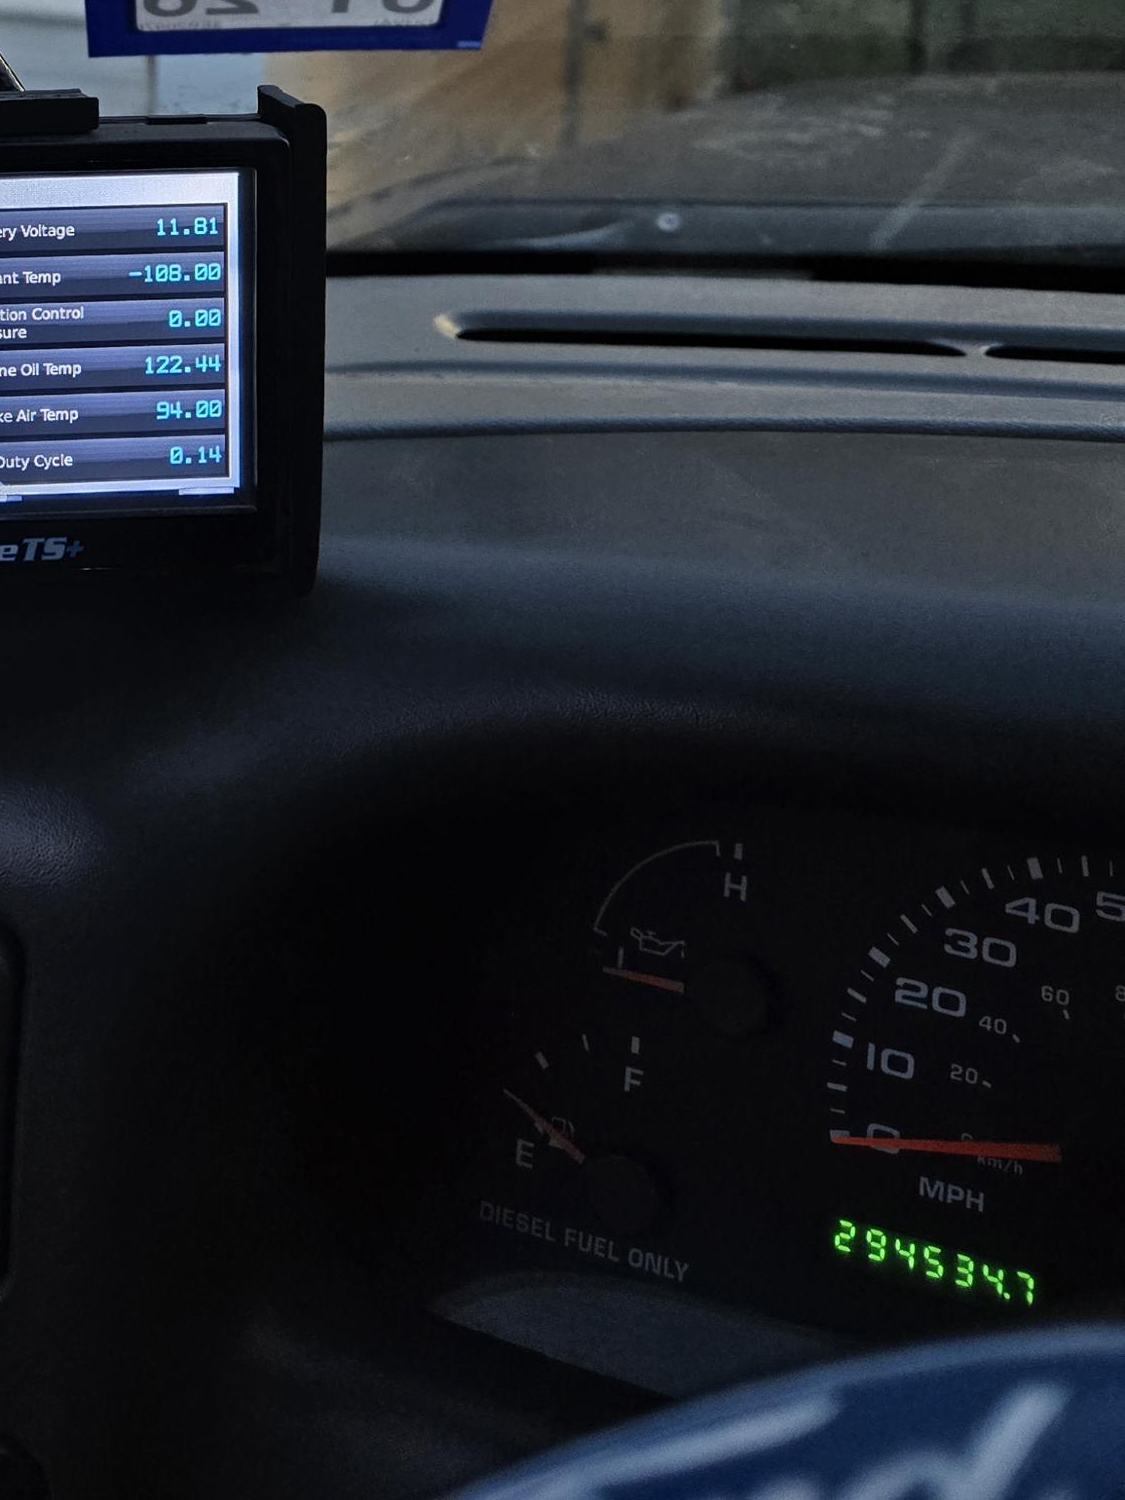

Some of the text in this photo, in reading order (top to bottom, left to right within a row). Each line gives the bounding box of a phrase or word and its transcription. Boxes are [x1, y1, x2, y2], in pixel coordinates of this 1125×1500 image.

[21, 224, 75, 240] Voltage
[157, 216, 219, 236] 11.81
[22, 271, 61, 287] Temp
[128, 263, 221, 283] -108.00
[31, 306, 84, 321] Control
[168, 309, 221, 328] 0.00
[21, 362, 40, 376] Oil
[43, 362, 82, 378] Temp
[145, 355, 221, 375] 122.44
[16, 409, 36, 422] Air
[40, 408, 79, 423] Temp
[156, 400, 222, 420] 94.00
[34, 453, 73, 469] Cycle
[169, 446, 222, 465] 0.14
[723, 872, 747, 902] H
[1004, 896, 1081, 934] 40
[942, 927, 1018, 968] 30
[893, 977, 968, 1018] 20
[1040, 984, 1070, 1006] 60
[978, 1015, 1008, 1036] 40
[866, 1042, 916, 1079] 10
[623, 1067, 644, 1093] F
[950, 1063, 978, 1085] 20
[515, 1138, 536, 1169] E
[917, 1175, 986, 1213] MPH
[479, 1200, 691, 1283] DIESEL FUEL ONLY
[834, 1218, 1035, 1307] 294534.7
